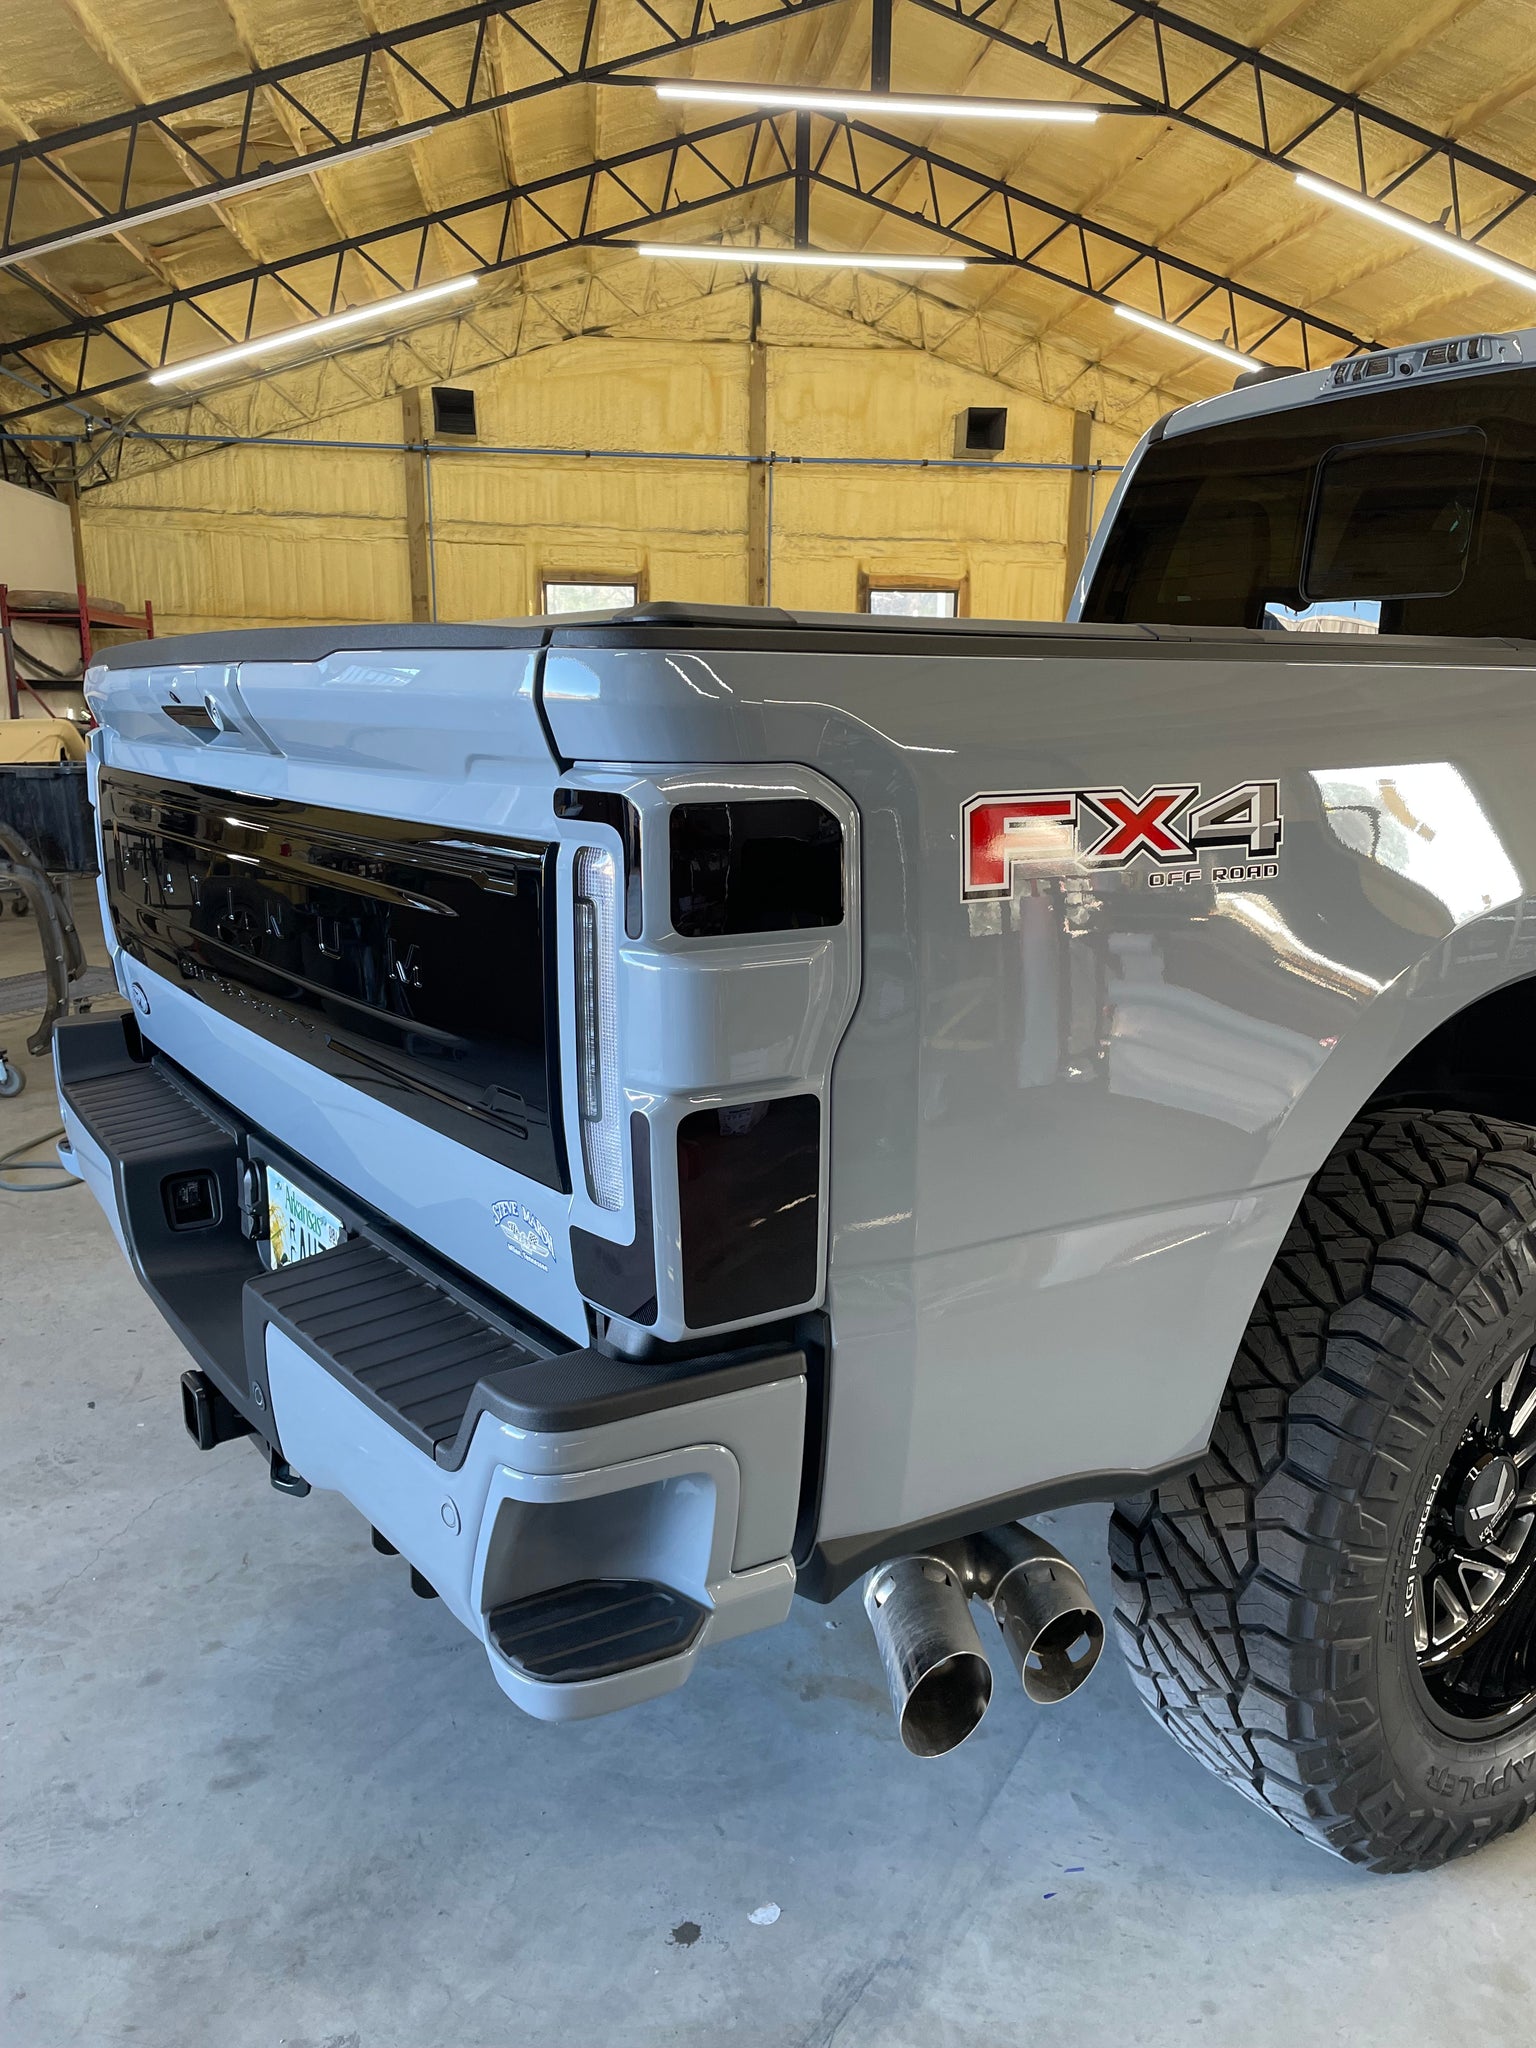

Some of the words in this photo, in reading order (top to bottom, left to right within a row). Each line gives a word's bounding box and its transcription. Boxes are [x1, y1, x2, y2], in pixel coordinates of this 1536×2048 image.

[960, 779, 1284, 903] FX4
[1149, 869, 1202, 887] OFF
[1211, 863, 1278, 882] ROAD
[122, 850, 422, 988] TINUM
[285, 1185, 322, 1237] Arkansas
[491, 1200, 519, 1227] STEVE
[1404, 1575, 1415, 1617] KG1
[1410, 1474, 1441, 1569] FORGED
